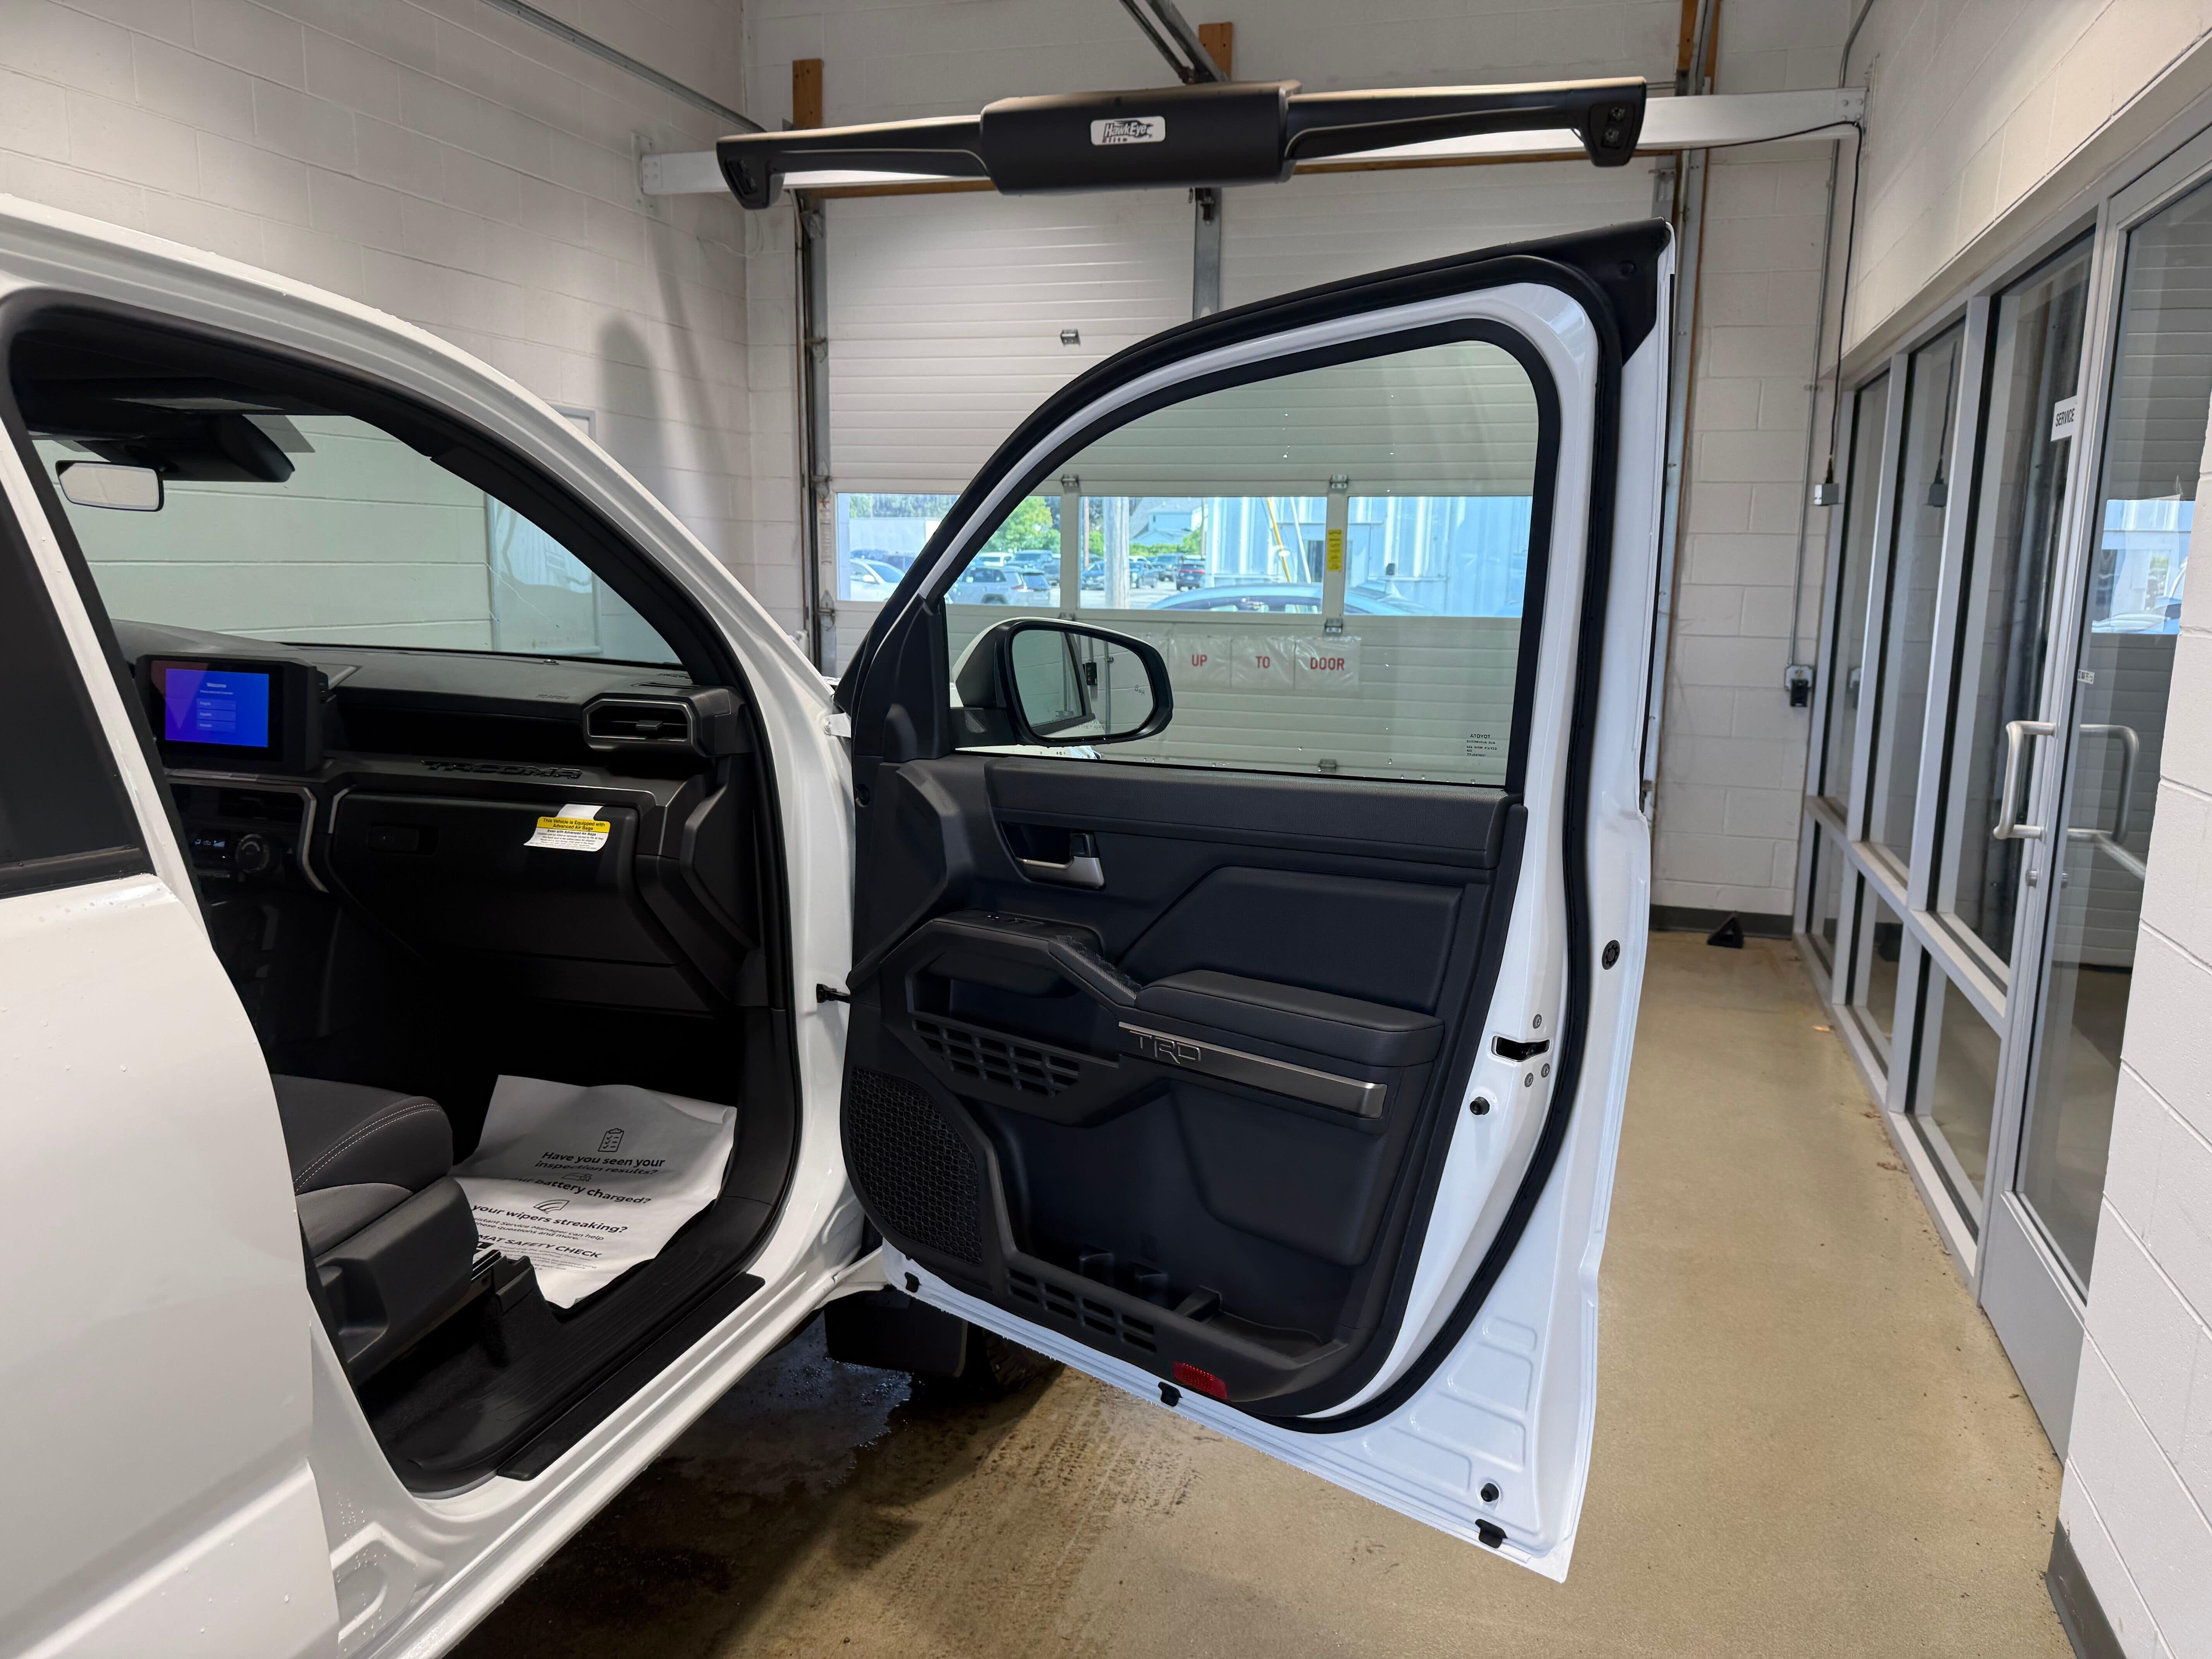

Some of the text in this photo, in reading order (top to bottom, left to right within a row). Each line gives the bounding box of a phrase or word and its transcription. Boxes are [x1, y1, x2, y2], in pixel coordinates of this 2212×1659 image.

[1104, 122, 1147, 137] HawkEye
[2056, 408, 2075, 427] SERVICE
[1191, 654, 1345, 670] UP TO DOOR
[421, 759, 583, 779] TACOMA
[1129, 1030, 1202, 1064] TRD
[535, 1161, 603, 1171] inspection
[542, 1152, 574, 1161] Have
[602, 1158, 633, 1166] seen
[634, 1159, 666, 1168] your
[534, 1179, 586, 1194] battery
[587, 1189, 651, 1204] charged?
[471, 1205, 628, 1233] your wipers streaking?
[497, 1226, 537, 1234] questions
[531, 1226, 568, 1234] Manager
[505, 1240, 555, 1249] SAFETY
[555, 1246, 603, 1258] CHECK
